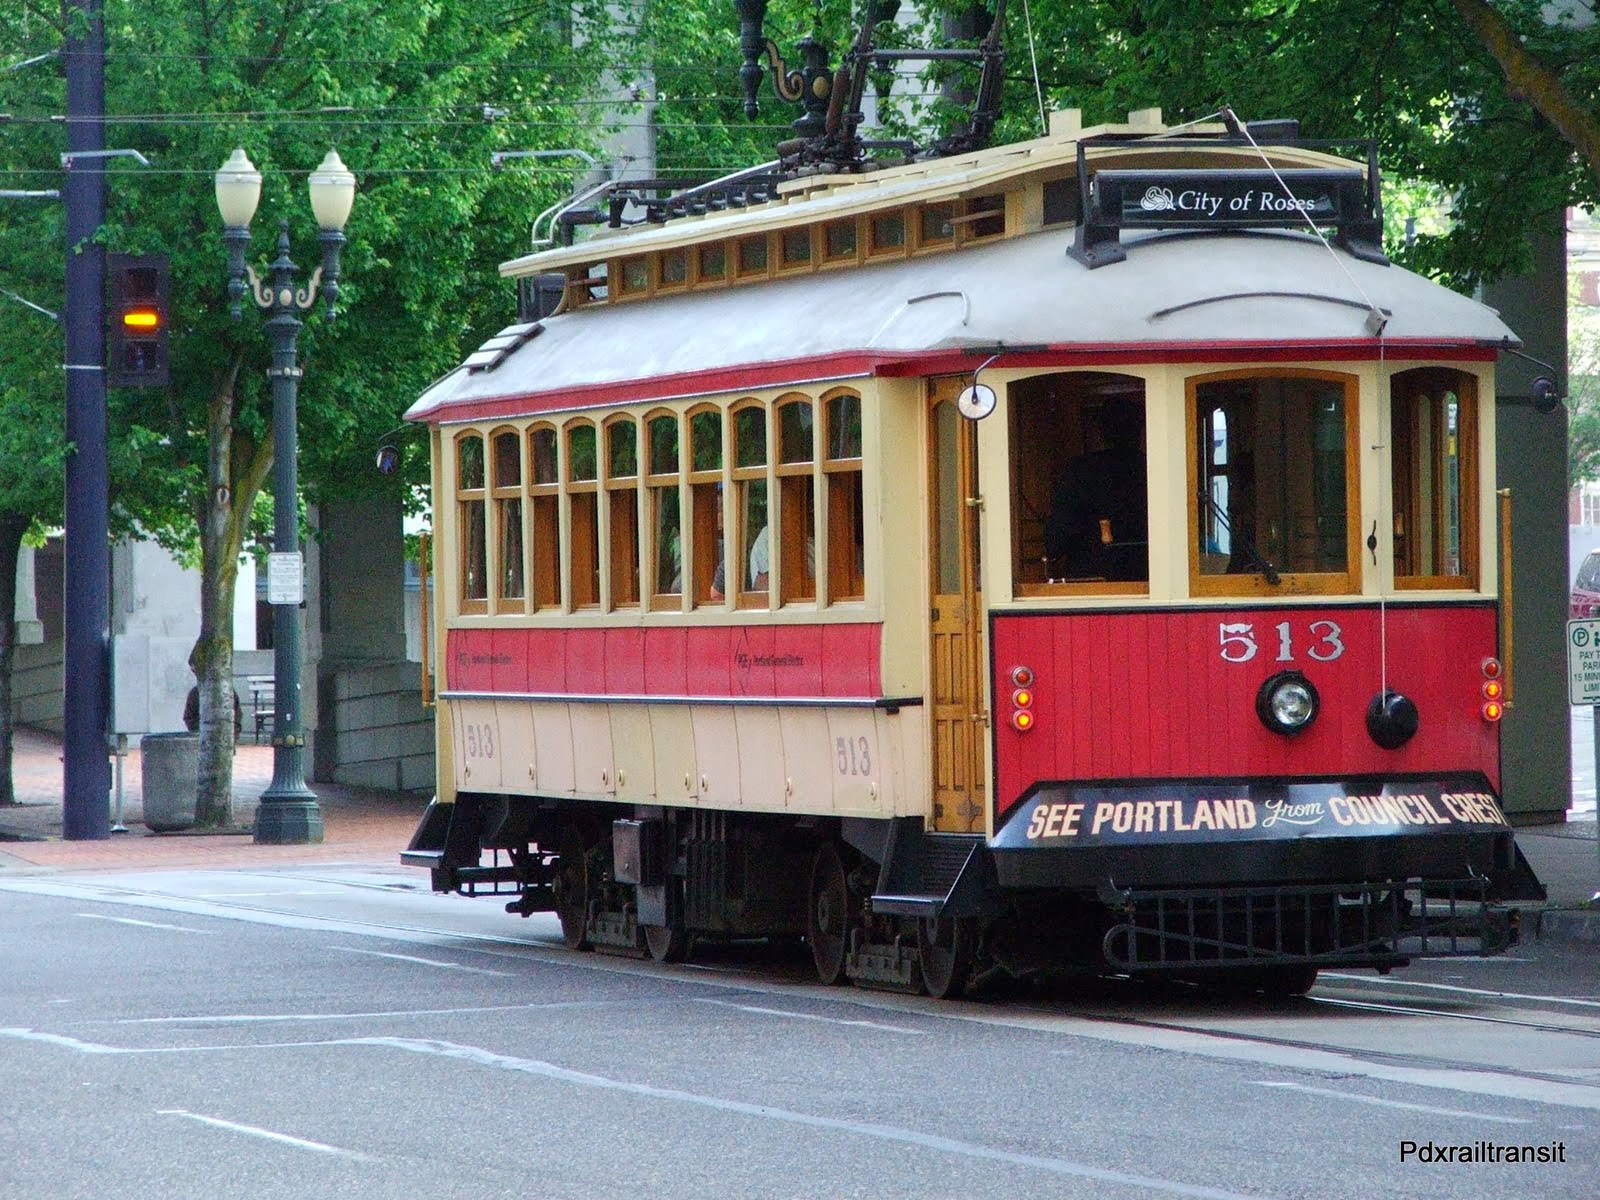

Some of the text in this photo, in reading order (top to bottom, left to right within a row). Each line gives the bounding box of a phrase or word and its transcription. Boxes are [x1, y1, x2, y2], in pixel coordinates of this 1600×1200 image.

[1178, 190, 1315, 216] City of Roses
[1219, 620, 1345, 662] 513
[1579, 651, 1594, 659] PAY
[1583, 661, 1600, 670] PAR
[467, 723, 495, 759] 513
[836, 736, 871, 776] 513
[1027, 803, 1085, 839] SEE
[1091, 799, 1257, 835] PORTLAND
[1328, 795, 1450, 826] COUNCIL
